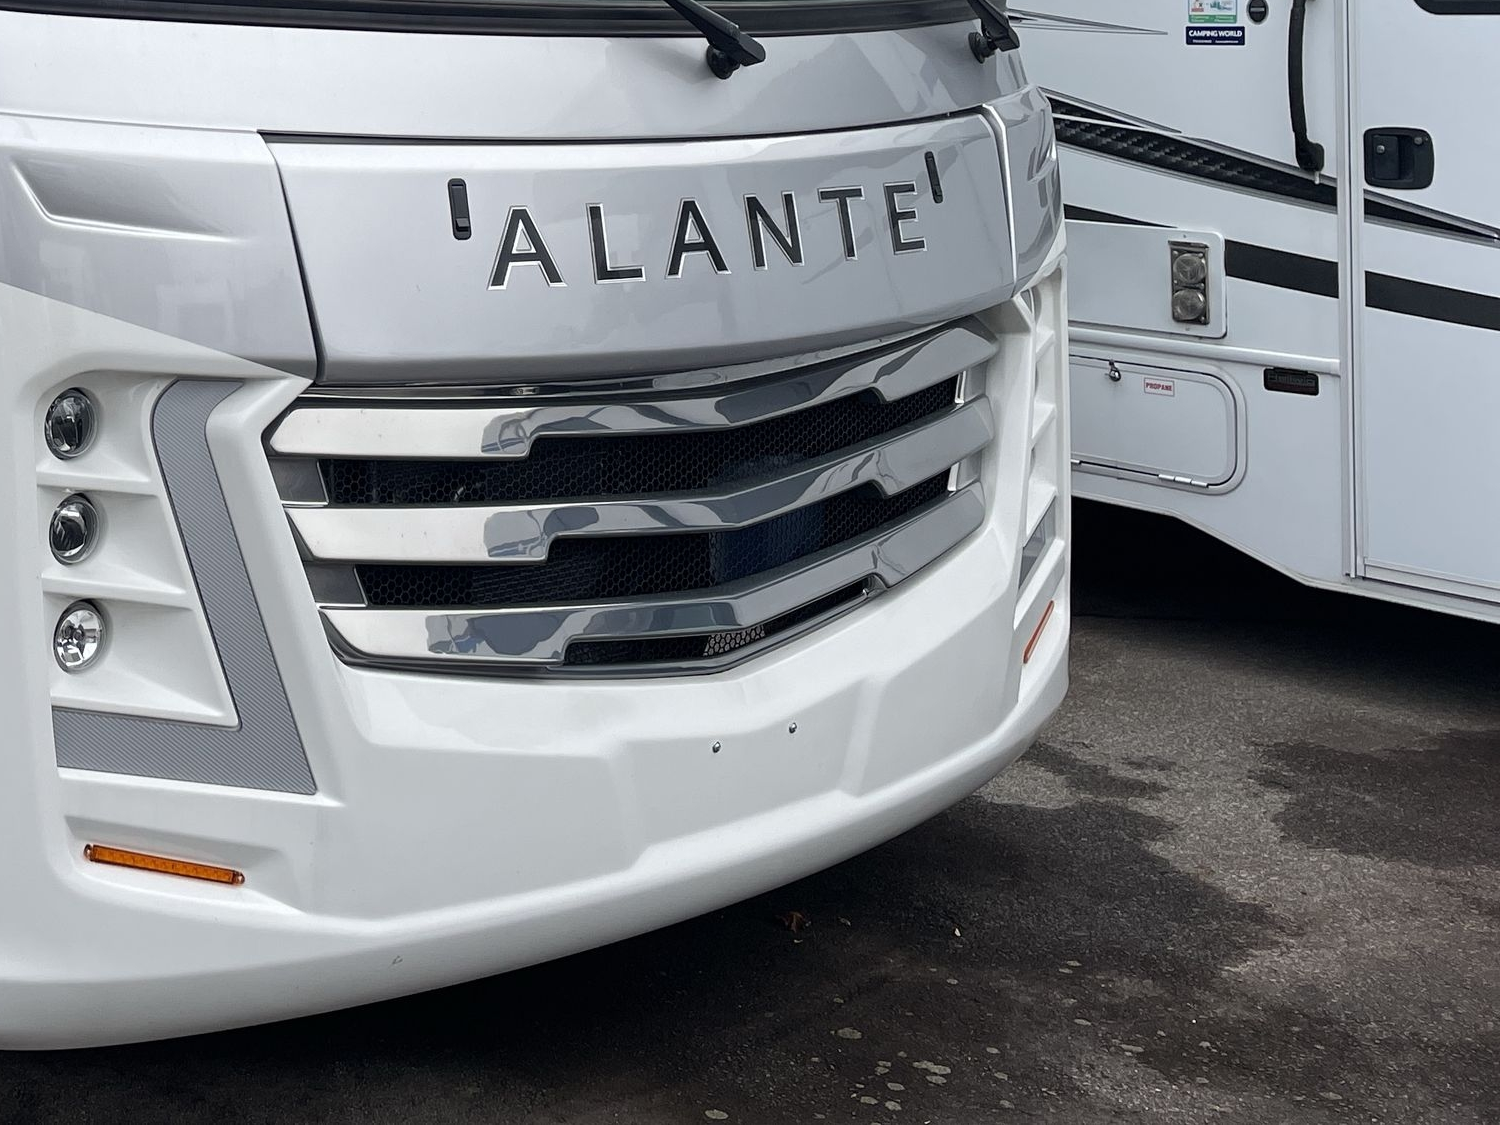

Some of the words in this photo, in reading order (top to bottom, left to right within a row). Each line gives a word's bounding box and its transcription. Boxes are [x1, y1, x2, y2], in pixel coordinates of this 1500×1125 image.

[1188, 29, 1217, 37] CAMPING
[1218, 29, 1243, 37] WORLD
[487, 180, 928, 291] ALANTE
